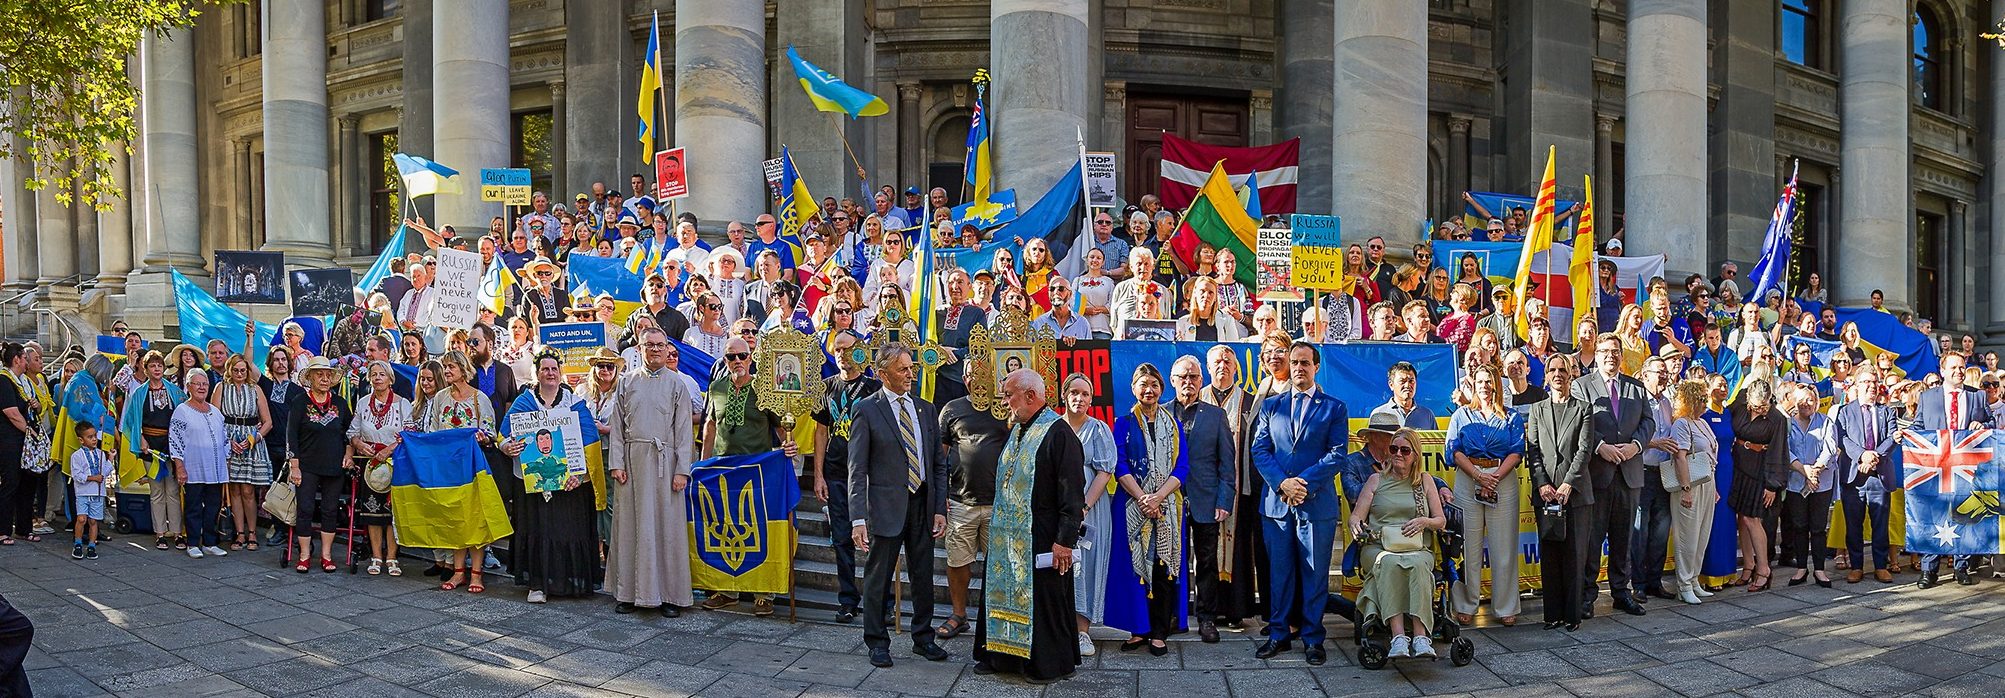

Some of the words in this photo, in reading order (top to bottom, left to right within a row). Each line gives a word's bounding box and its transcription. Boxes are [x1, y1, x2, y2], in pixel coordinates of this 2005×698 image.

[764, 157, 785, 168] BLOC
[508, 174, 526, 183] PUTIN
[665, 180, 679, 188] STOP
[486, 190, 498, 198] our
[1296, 217, 1336, 229] RUSSIA
[1260, 231, 1292, 239] BLOC
[1315, 232, 1336, 241] will
[1300, 241, 1339, 256] NEVER
[441, 254, 477, 271] RUSSIA
[448, 271, 466, 282] WE
[437, 297, 471, 314] forgive
[1056, 349, 1110, 396] TOP
[530, 410, 548, 421] NO!
[543, 416, 572, 427] division
